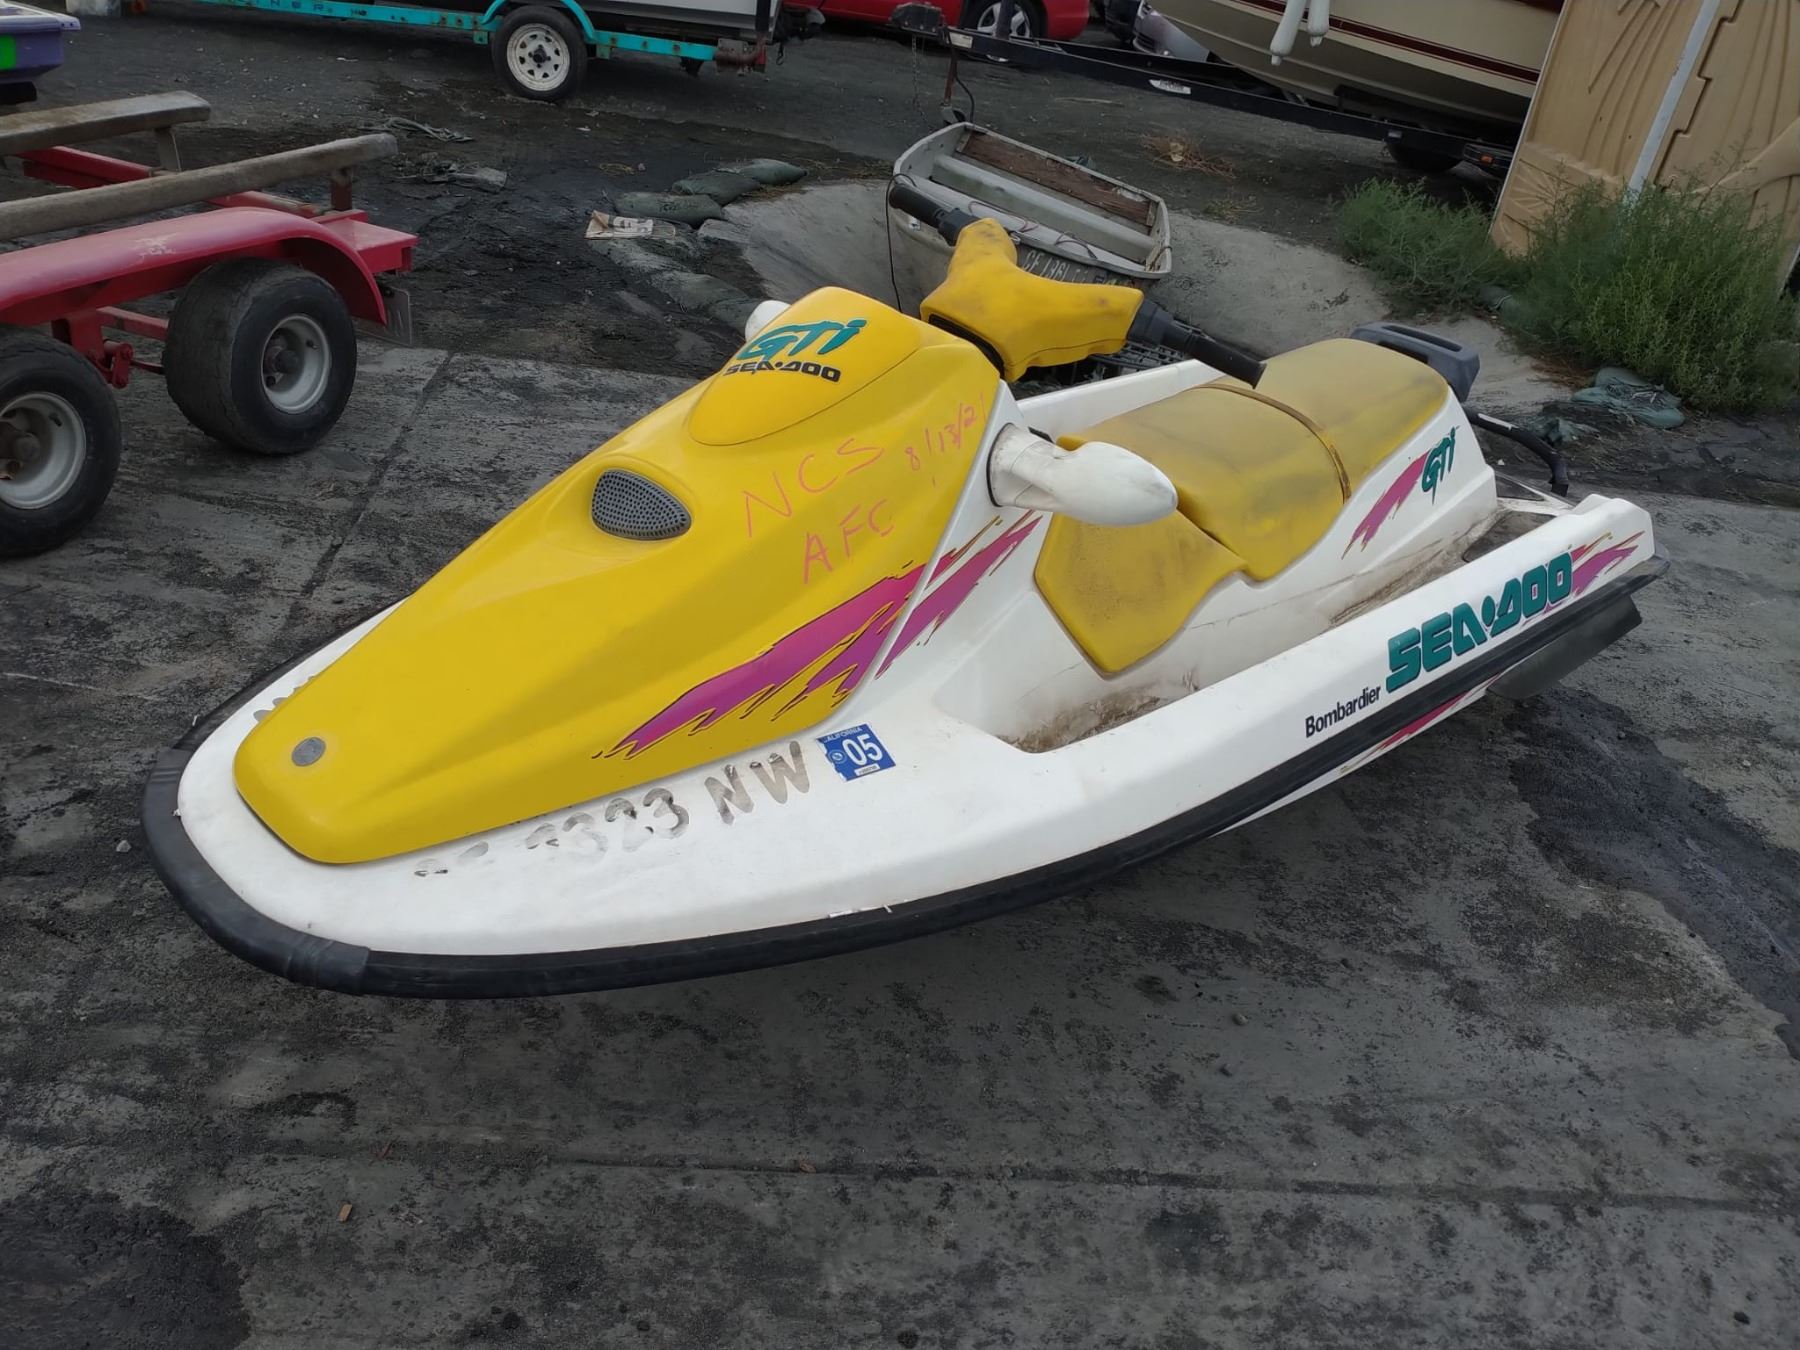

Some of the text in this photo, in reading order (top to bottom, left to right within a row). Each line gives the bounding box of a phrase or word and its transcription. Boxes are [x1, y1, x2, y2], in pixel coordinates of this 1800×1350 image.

[743, 438, 885, 538] NCS
[804, 499, 894, 584] AFC
[842, 733, 883, 766] 05
[1305, 685, 1381, 738] Bombardier
[705, 740, 810, 826] NW
